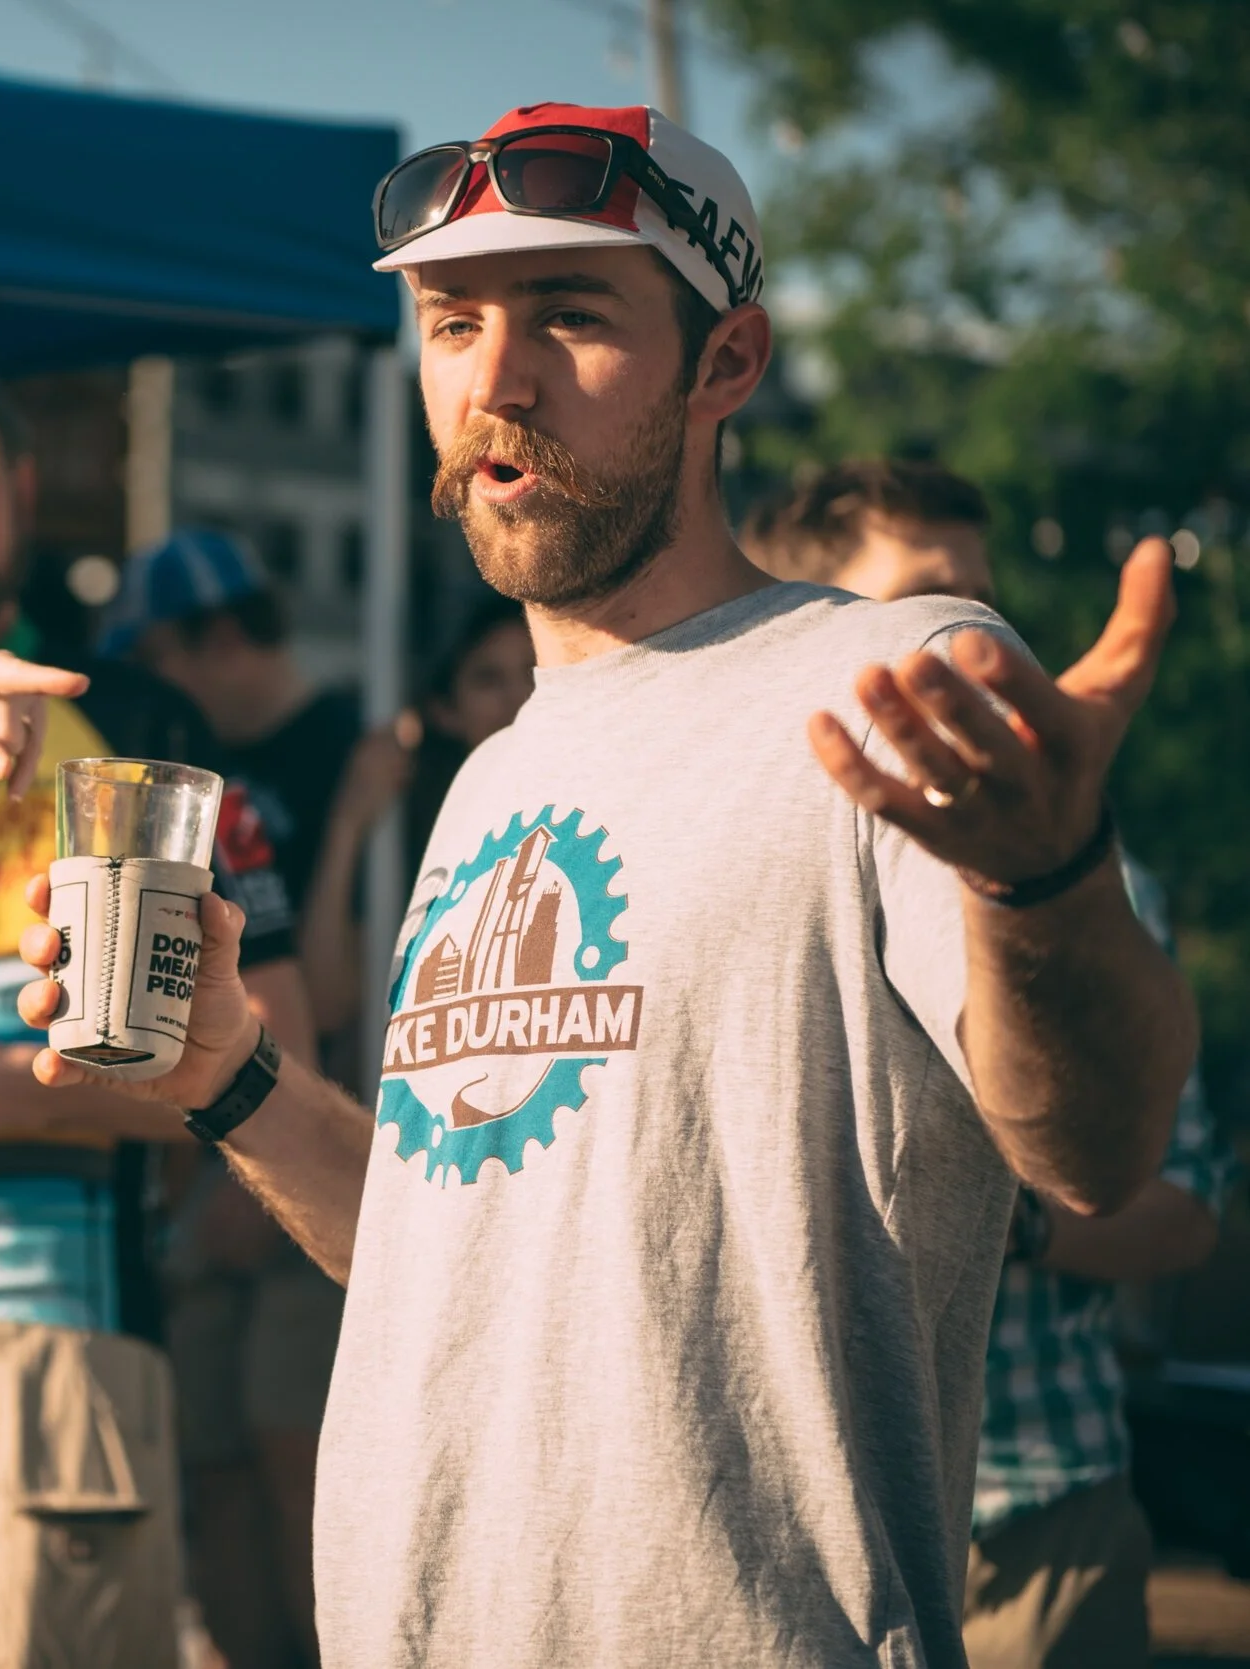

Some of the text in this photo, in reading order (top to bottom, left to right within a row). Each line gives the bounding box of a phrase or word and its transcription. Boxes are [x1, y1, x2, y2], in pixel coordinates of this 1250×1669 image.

[646, 165, 666, 190] SMITH
[667, 177, 765, 302] AEM
[146, 974, 193, 1002] PEOP
[383, 992, 636, 1069] IKE DURHAM
